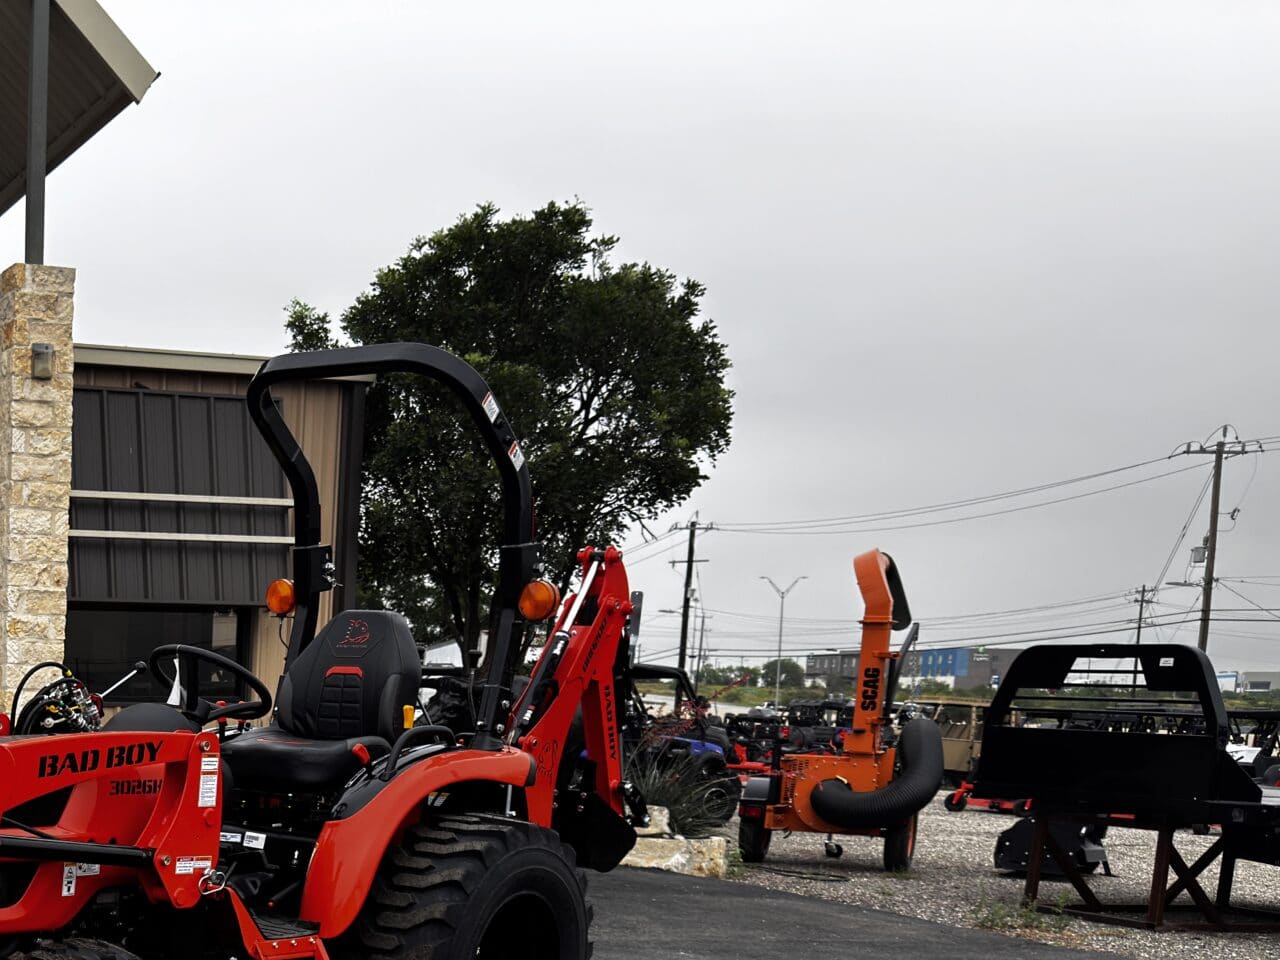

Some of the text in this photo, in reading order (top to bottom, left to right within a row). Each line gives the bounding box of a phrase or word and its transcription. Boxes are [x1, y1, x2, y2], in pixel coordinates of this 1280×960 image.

[861, 668, 880, 711] SCAG
[38, 740, 164, 778] BAD BOY
